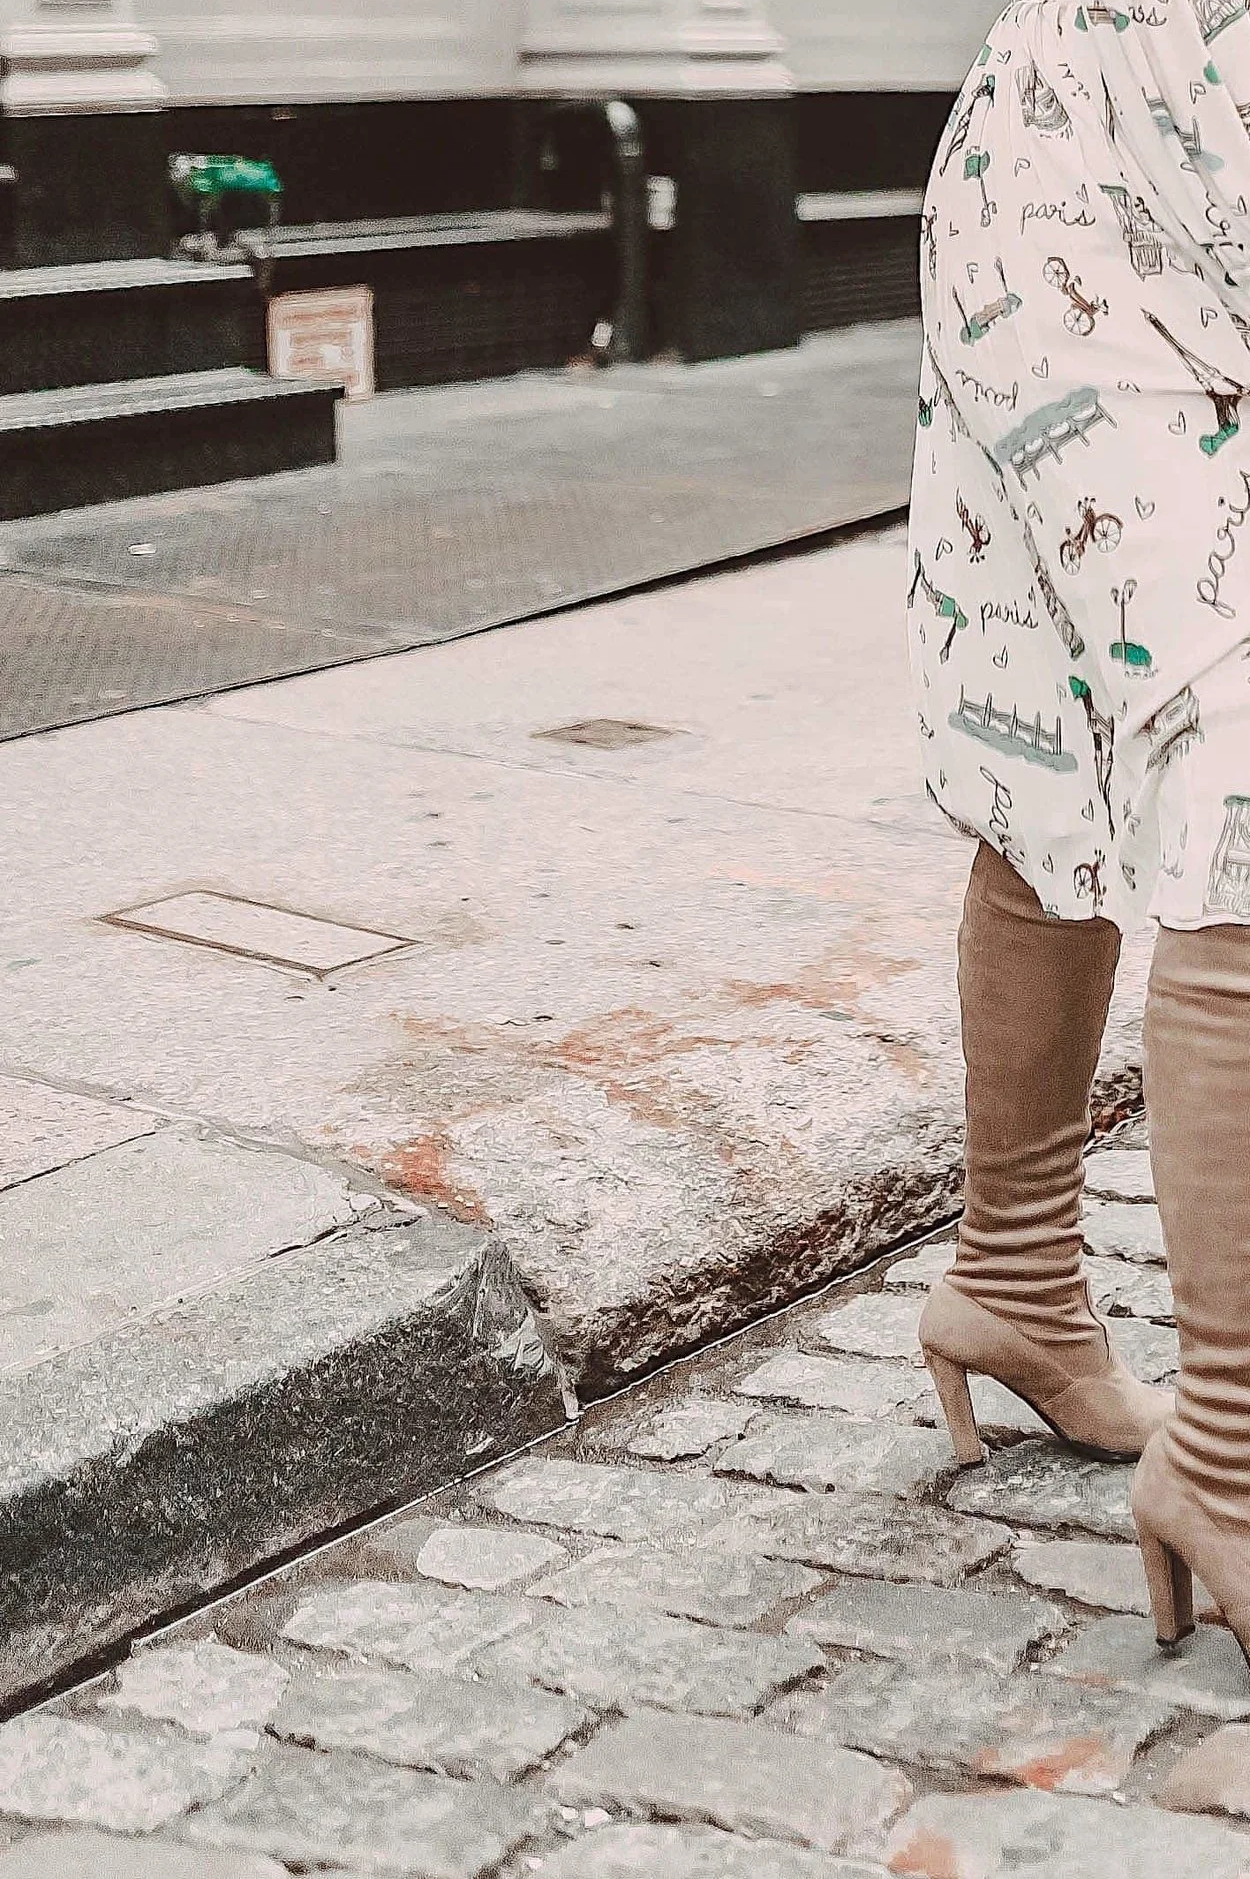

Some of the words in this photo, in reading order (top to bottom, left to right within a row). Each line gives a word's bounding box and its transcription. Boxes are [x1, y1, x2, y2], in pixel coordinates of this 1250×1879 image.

[1020, 201, 1096, 235] paris
[956, 369, 1019, 412] paris
[980, 600, 1039, 637] paris
[979, 765, 1025, 866] pari
